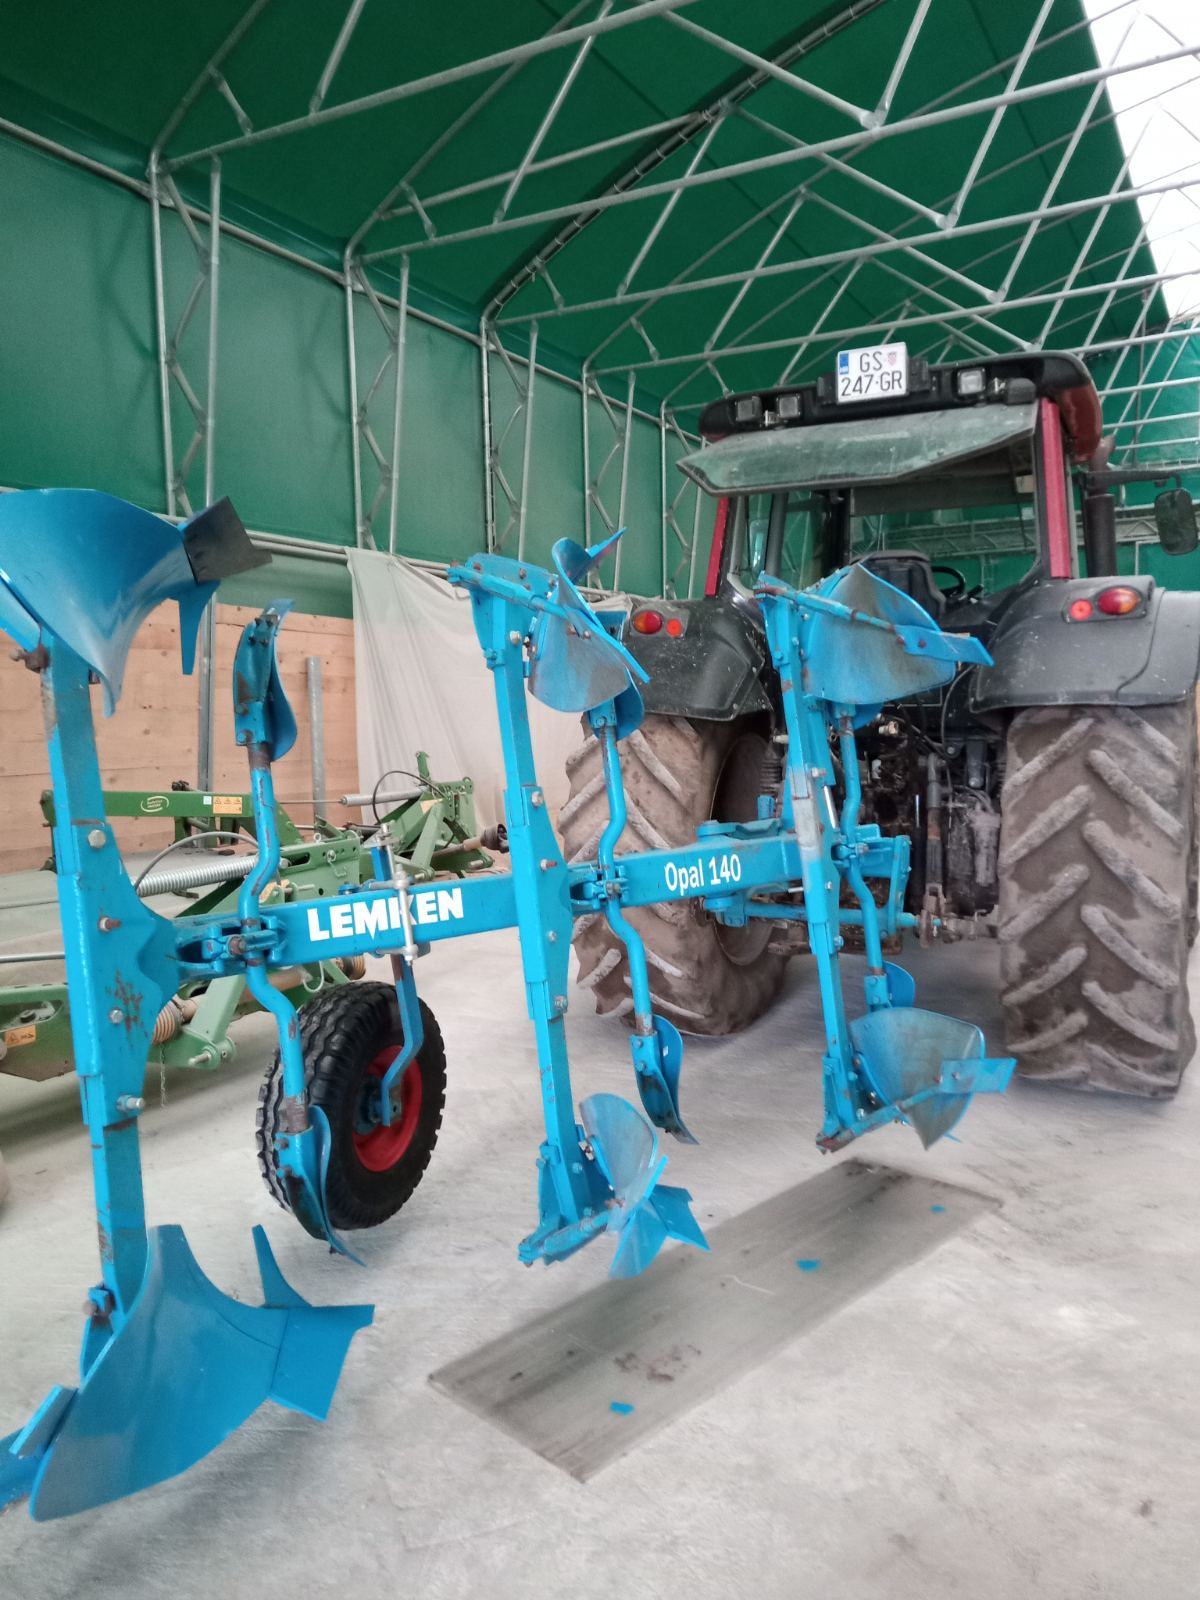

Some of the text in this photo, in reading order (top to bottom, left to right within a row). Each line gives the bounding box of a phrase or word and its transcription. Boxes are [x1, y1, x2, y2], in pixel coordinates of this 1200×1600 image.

[860, 351, 882, 373] GS
[664, 854, 741, 896] Opal 140
